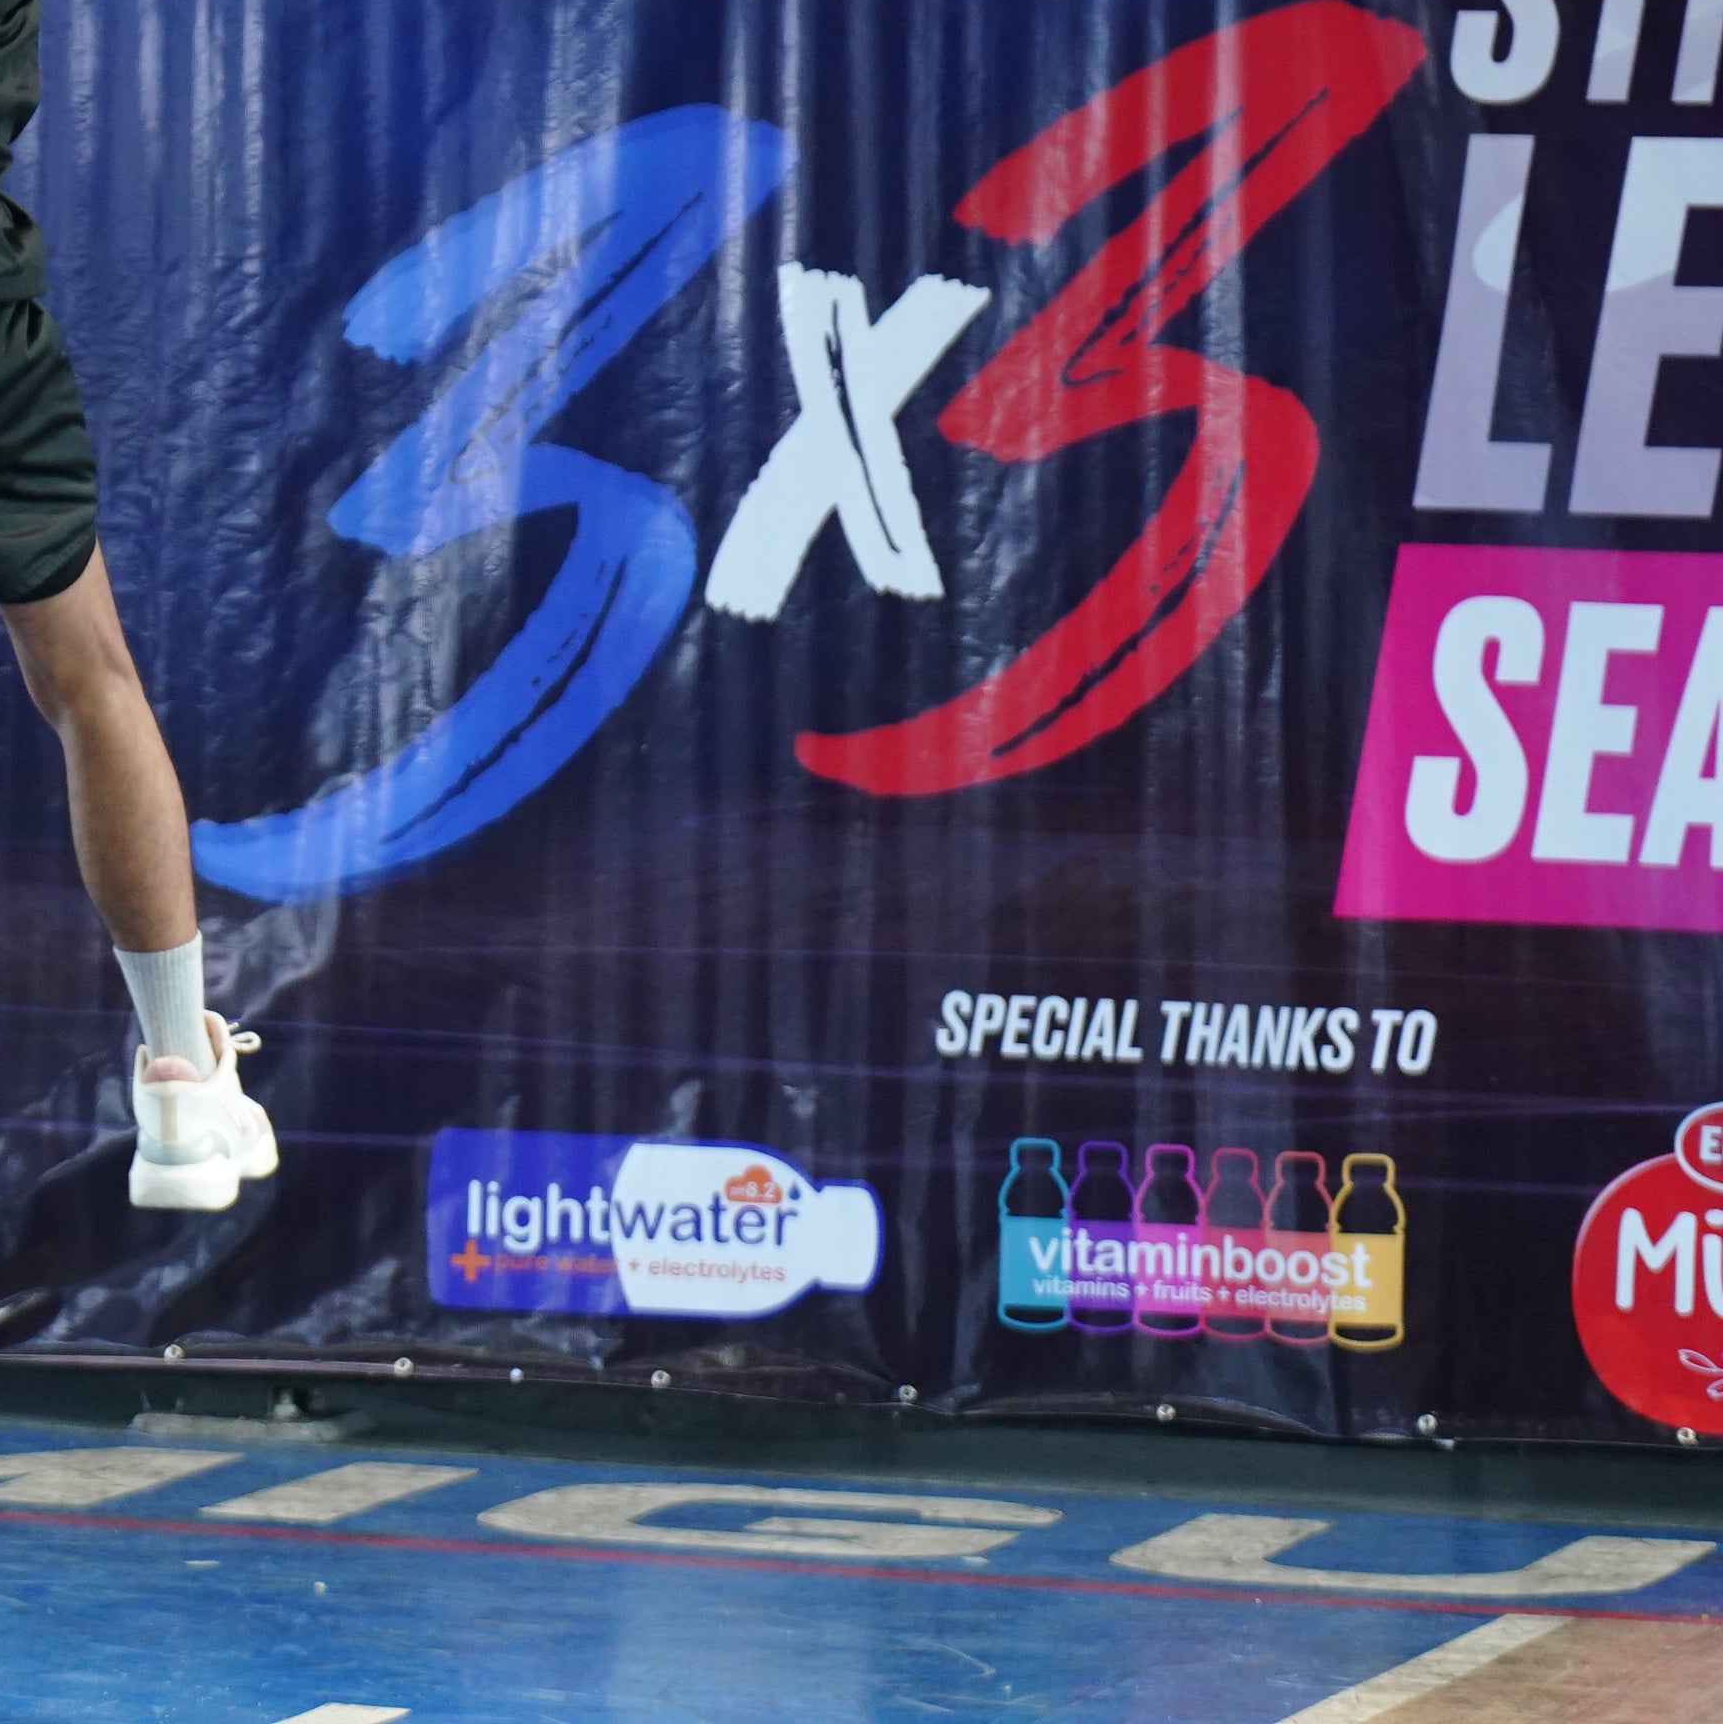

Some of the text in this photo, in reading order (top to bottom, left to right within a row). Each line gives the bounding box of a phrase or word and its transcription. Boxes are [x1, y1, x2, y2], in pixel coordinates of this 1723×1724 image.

[935, 989, 1439, 1076] SPECIAL THANKS TO
[467, 1178, 799, 1255] lightwater
[648, 1257, 786, 1284] electrolytes
[1029, 1227, 1373, 1288] vitaminboost
[1033, 1275, 1130, 1299] vitamins
[1153, 1279, 1212, 1304] fruits
[1235, 1288, 1367, 1318] electrolytes
